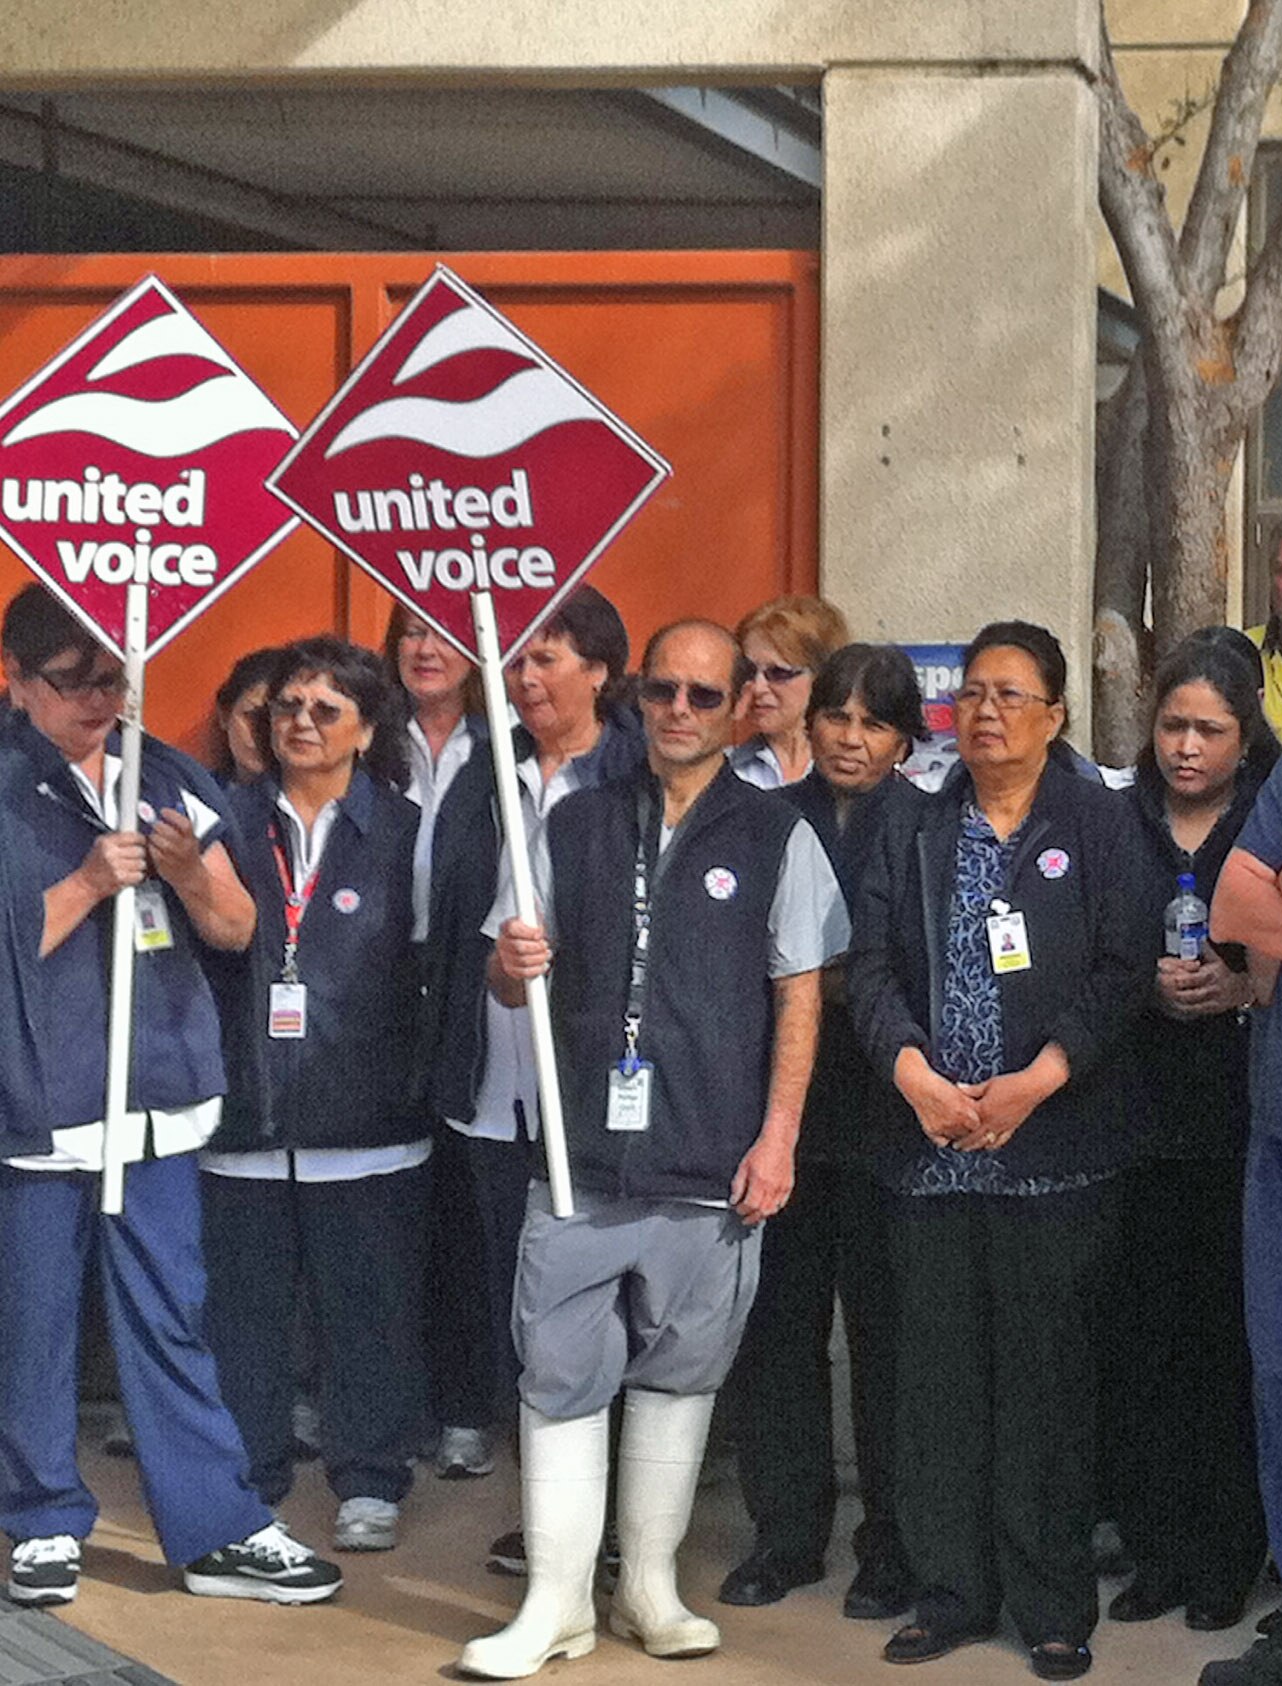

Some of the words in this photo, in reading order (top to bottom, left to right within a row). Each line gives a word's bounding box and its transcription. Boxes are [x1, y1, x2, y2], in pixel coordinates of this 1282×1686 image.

[1, 464, 206, 527] united
[333, 469, 534, 532] united
[56, 528, 219, 586] voice
[396, 533, 557, 592] voice
